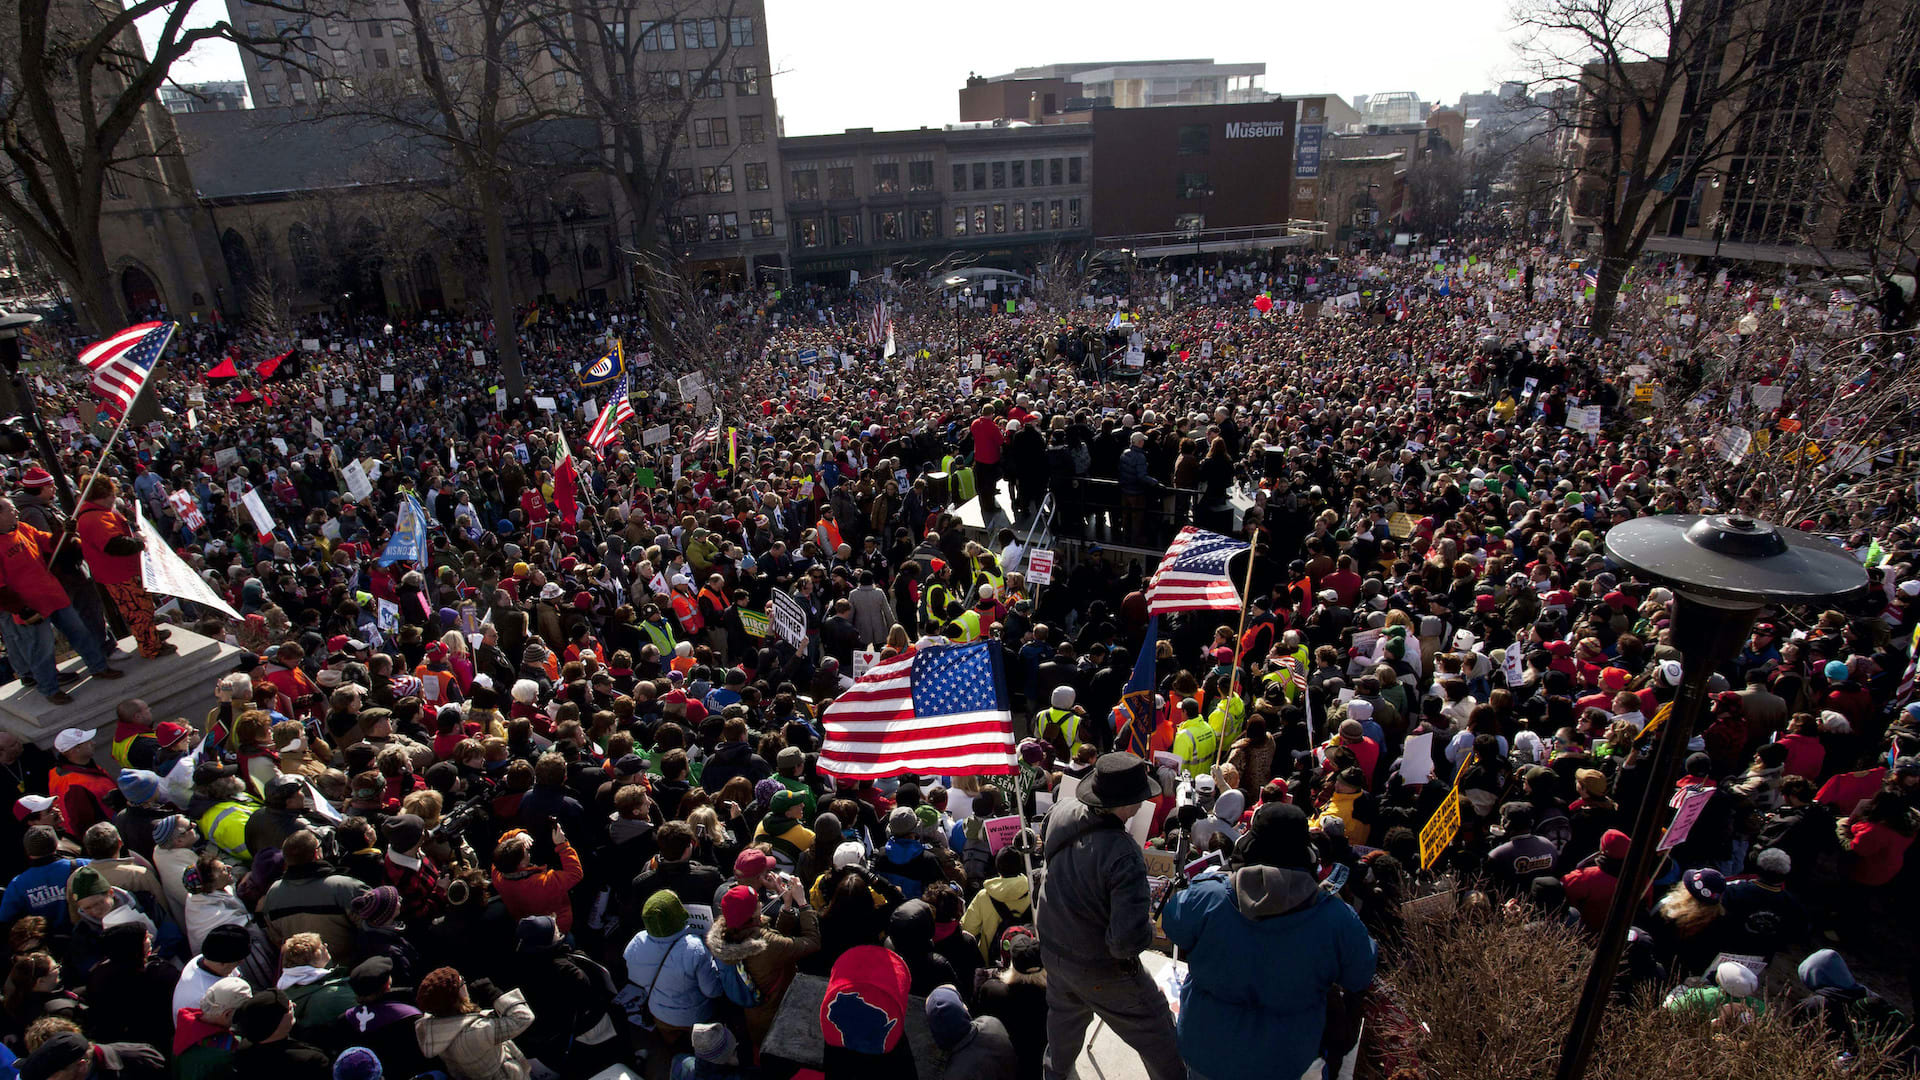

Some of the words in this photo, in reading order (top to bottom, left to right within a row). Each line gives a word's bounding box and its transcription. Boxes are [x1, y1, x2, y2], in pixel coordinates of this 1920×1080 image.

[1225, 122, 1283, 139] Museum
[804, 260, 856, 271] ATTICUS
[774, 606, 802, 637] NEITHER
[997, 776, 1028, 801] SENE
